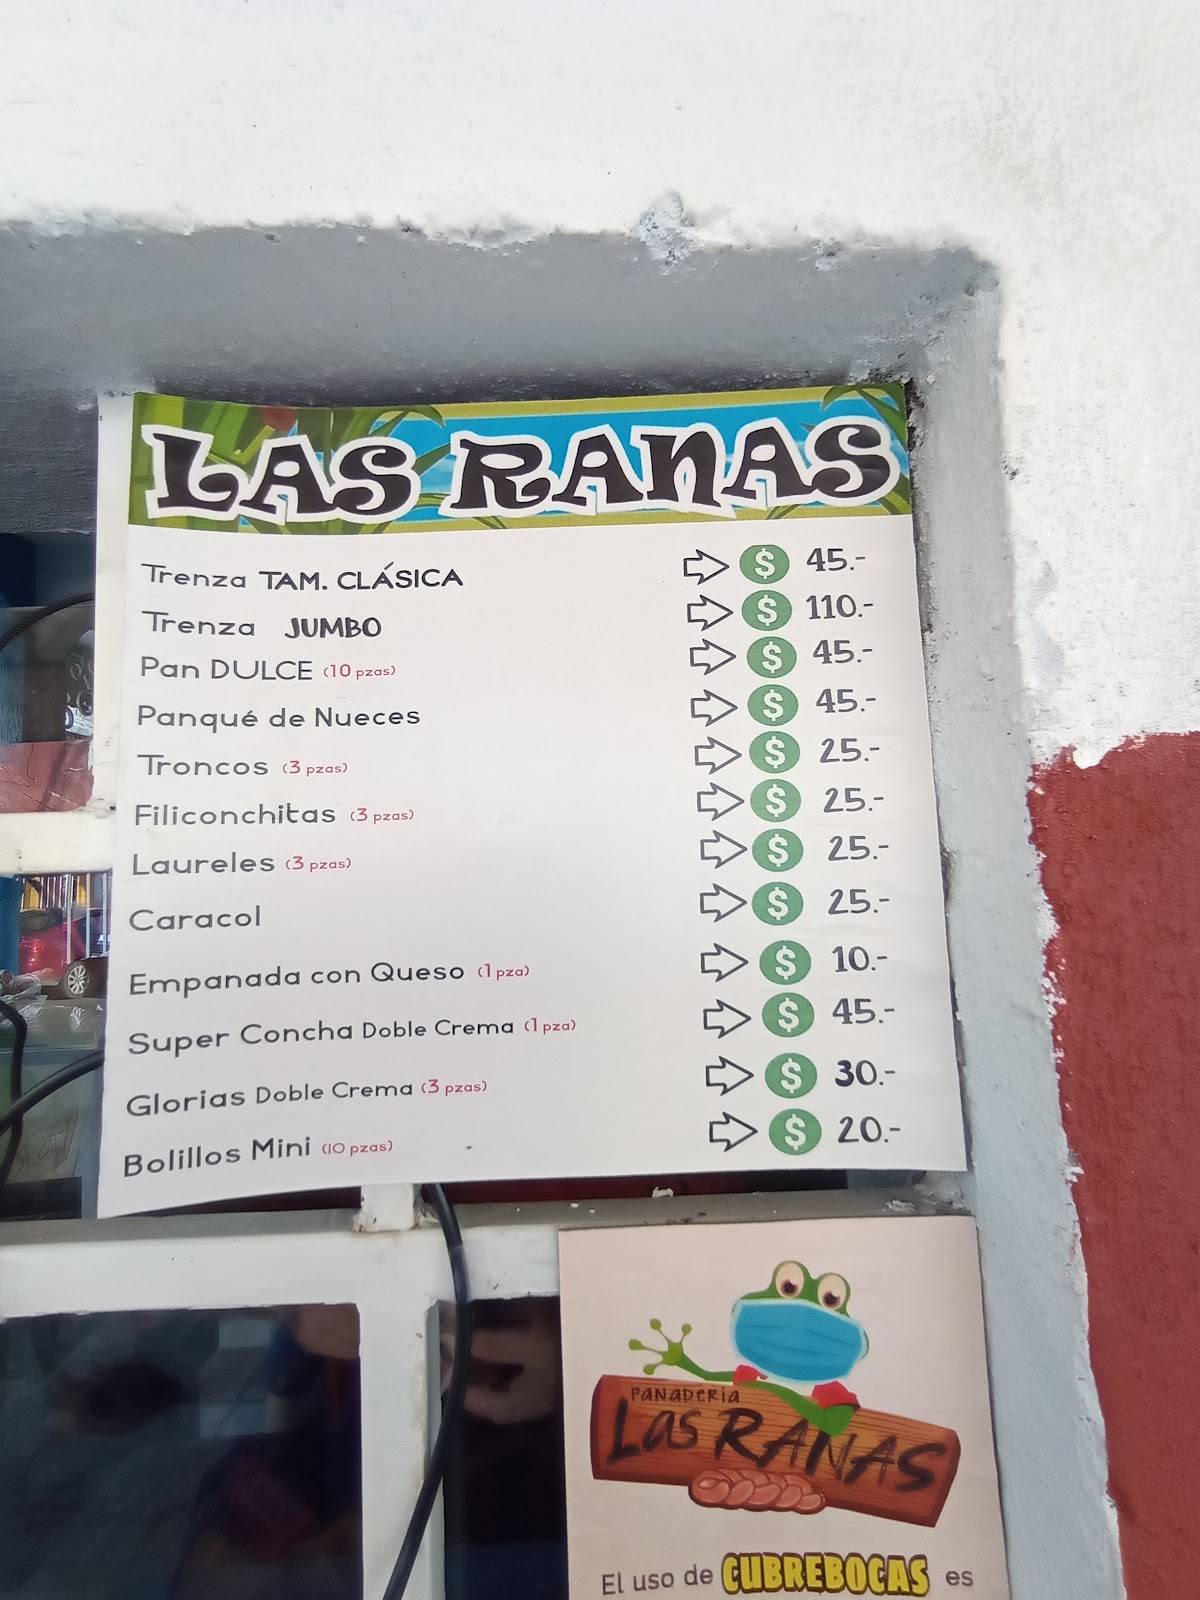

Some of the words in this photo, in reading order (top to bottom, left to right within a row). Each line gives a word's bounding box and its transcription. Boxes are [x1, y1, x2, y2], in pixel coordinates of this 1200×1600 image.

[141, 424, 422, 526] LAS
[439, 416, 901, 518] RANAS
[141, 563, 246, 588] Trenza
[259, 571, 327, 590] TAM.
[337, 562, 463, 590] CLÁSICA
[755, 548, 775, 579] $
[807, 548, 865, 571] 45.-
[142, 611, 254, 636] Trenza
[285, 617, 381, 638] JUMBO
[757, 595, 777, 626] $
[806, 595, 873, 619] 110.-
[142, 656, 199, 678] Pan
[211, 659, 312, 680] DULCE
[324, 664, 351, 677] (10
[356, 666, 395, 680] pzas)
[762, 641, 782, 673] $
[813, 640, 872, 664] 45.-
[138, 705, 258, 733] Panqué
[269, 708, 305, 727] de
[316, 707, 420, 727] Nueces
[763, 689, 783, 721] $
[816, 689, 876, 713] 45.-
[137, 755, 268, 775] Troncos
[283, 761, 300, 773] (3
[307, 763, 347, 776] pzas)
[765, 736, 785, 768] $
[820, 738, 880, 763] 25.-
[136, 803, 335, 825] Filiconchitas
[351, 808, 368, 821] (3
[374, 810, 414, 824] pzas)
[766, 784, 786, 817] $
[824, 788, 884, 813] 25.-
[133, 852, 275, 875] Laureles
[286, 856, 304, 870] (3
[310, 858, 351, 872] pzas)
[768, 834, 788, 867] $
[828, 836, 888, 861] 25.-
[130, 905, 260, 931] Caracol
[768, 887, 788, 920] $
[828, 889, 889, 915] 25.-
[130, 966, 300, 998] Empanada
[311, 970, 360, 984] con
[371, 962, 464, 982] Queso
[478, 964, 490, 977] (1
[497, 966, 529, 981] pza)
[776, 946, 796, 980] $
[832, 946, 887, 972] 10.-
[129, 1033, 229, 1058] Super
[241, 1020, 352, 1044] Concha
[363, 1021, 426, 1039] Doble
[435, 1020, 513, 1035] Crema
[525, 1018, 537, 1032] (1
[543, 1020, 576, 1035] pza)
[778, 998, 799, 1032] $
[832, 998, 895, 1024] 45.-
[127, 1090, 245, 1116] Glorias
[257, 1083, 324, 1104] Doble
[332, 1082, 412, 1098] Crema
[421, 1079, 439, 1093] (3
[446, 1081, 486, 1096] pzas)
[781, 1058, 801, 1093] $
[835, 1060, 895, 1087] 30.-
[124, 1146, 240, 1177] Bolillos
[252, 1137, 310, 1160] Mini
[322, 1143, 345, 1154] (10
[350, 1140, 392, 1157] pzas)
[785, 1114, 806, 1150] $
[838, 1116, 900, 1143] 20.-
[714, 1407, 947, 1493] RANAS
[602, 1571, 624, 1595] El
[633, 1571, 674, 1591] uso
[684, 1565, 714, 1586] de
[721, 1552, 930, 1597] CUBREBOCAS
[946, 1570, 973, 1587] es
